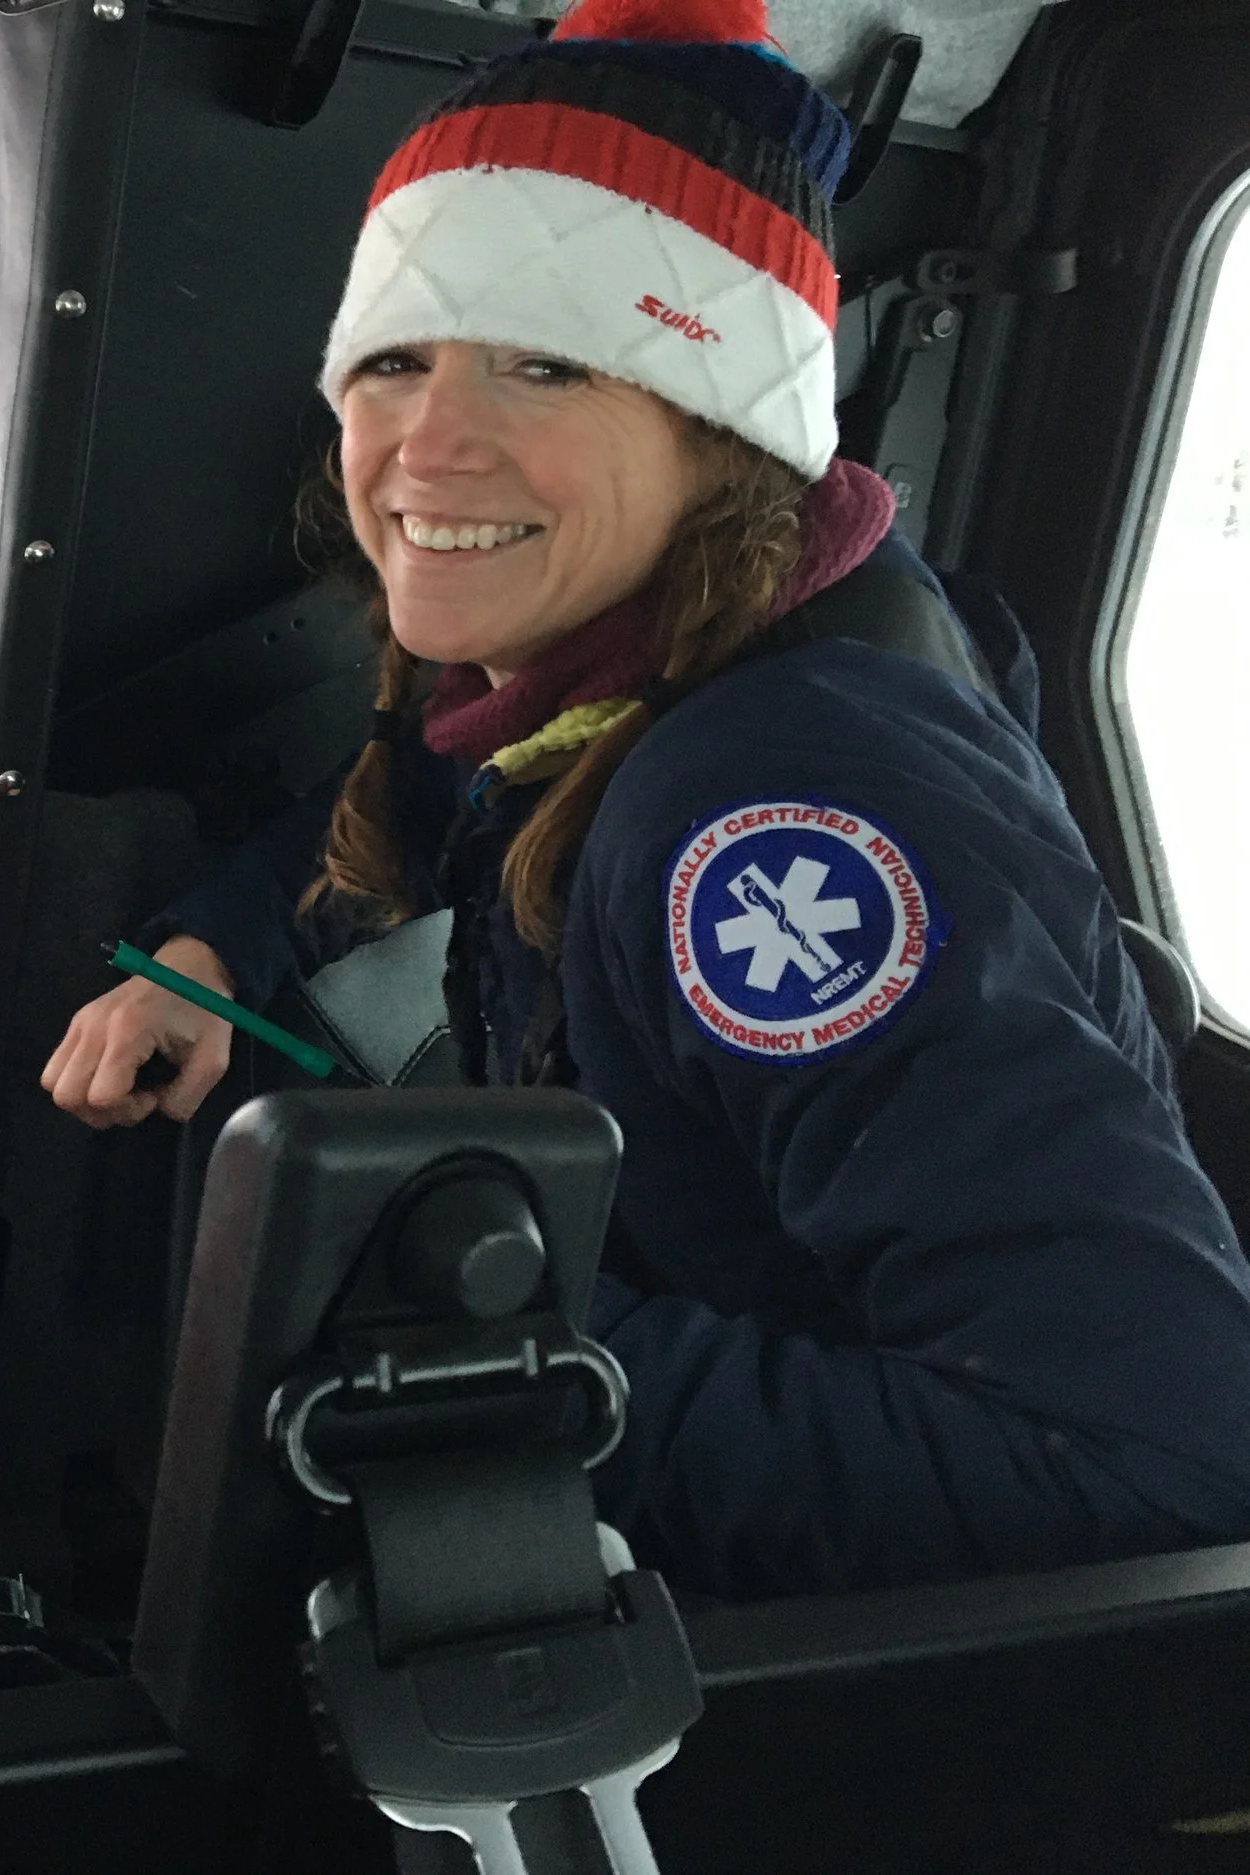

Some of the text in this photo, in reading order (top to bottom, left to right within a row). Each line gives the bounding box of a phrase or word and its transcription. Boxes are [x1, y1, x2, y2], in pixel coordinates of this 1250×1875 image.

[671, 807, 860, 974] NATIONALLY CERTIFIED
[688, 836, 927, 1051] EMERGENCY MEDICAL TECHNICIAN
[810, 960, 868, 1006] NREMT
